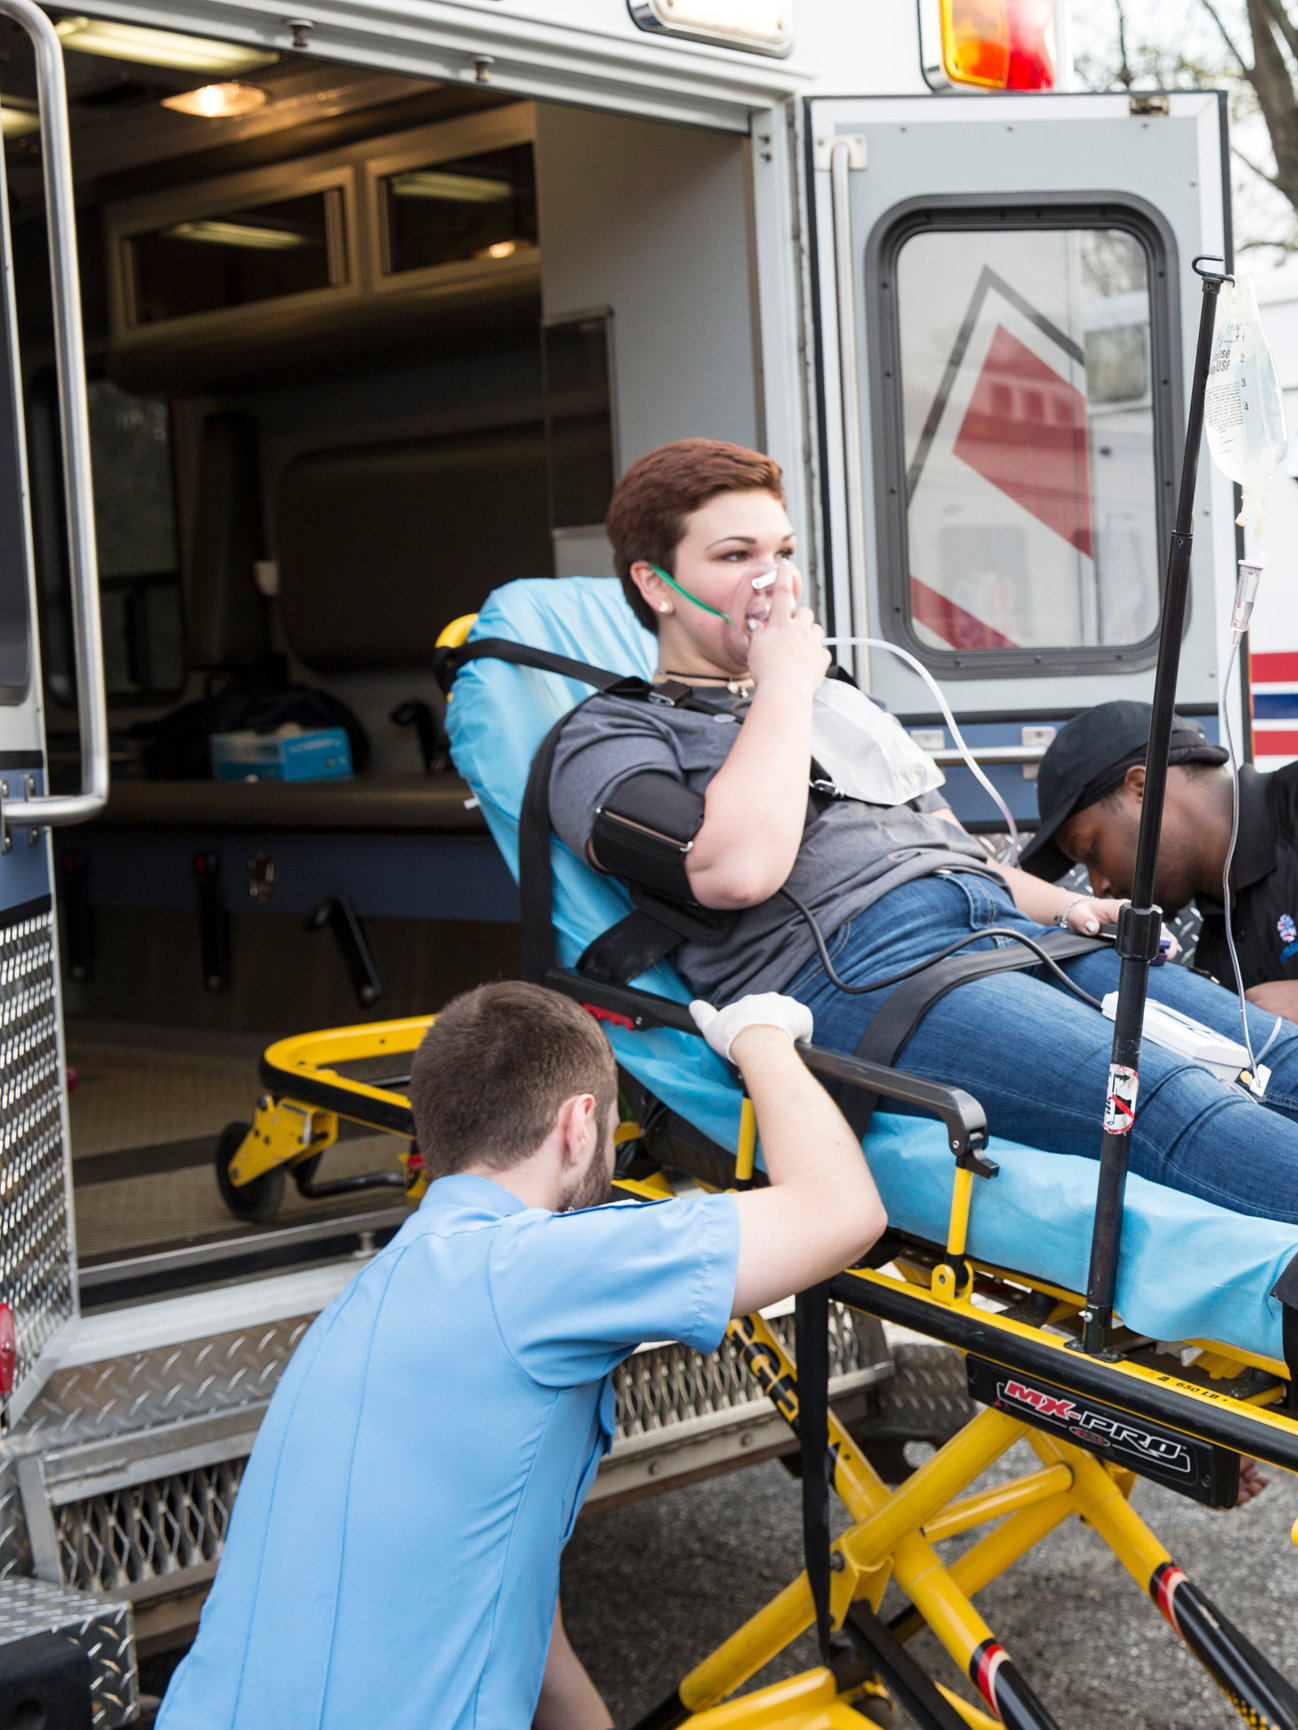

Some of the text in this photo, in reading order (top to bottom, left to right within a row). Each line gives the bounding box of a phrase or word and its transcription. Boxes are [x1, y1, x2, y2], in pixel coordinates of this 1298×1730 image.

[1241, 378, 1247, 388] 3
[1243, 402, 1250, 412] 4
[1175, 1382, 1220, 1400] 650 LB
[1004, 1379, 1182, 1460] MX-PRO
